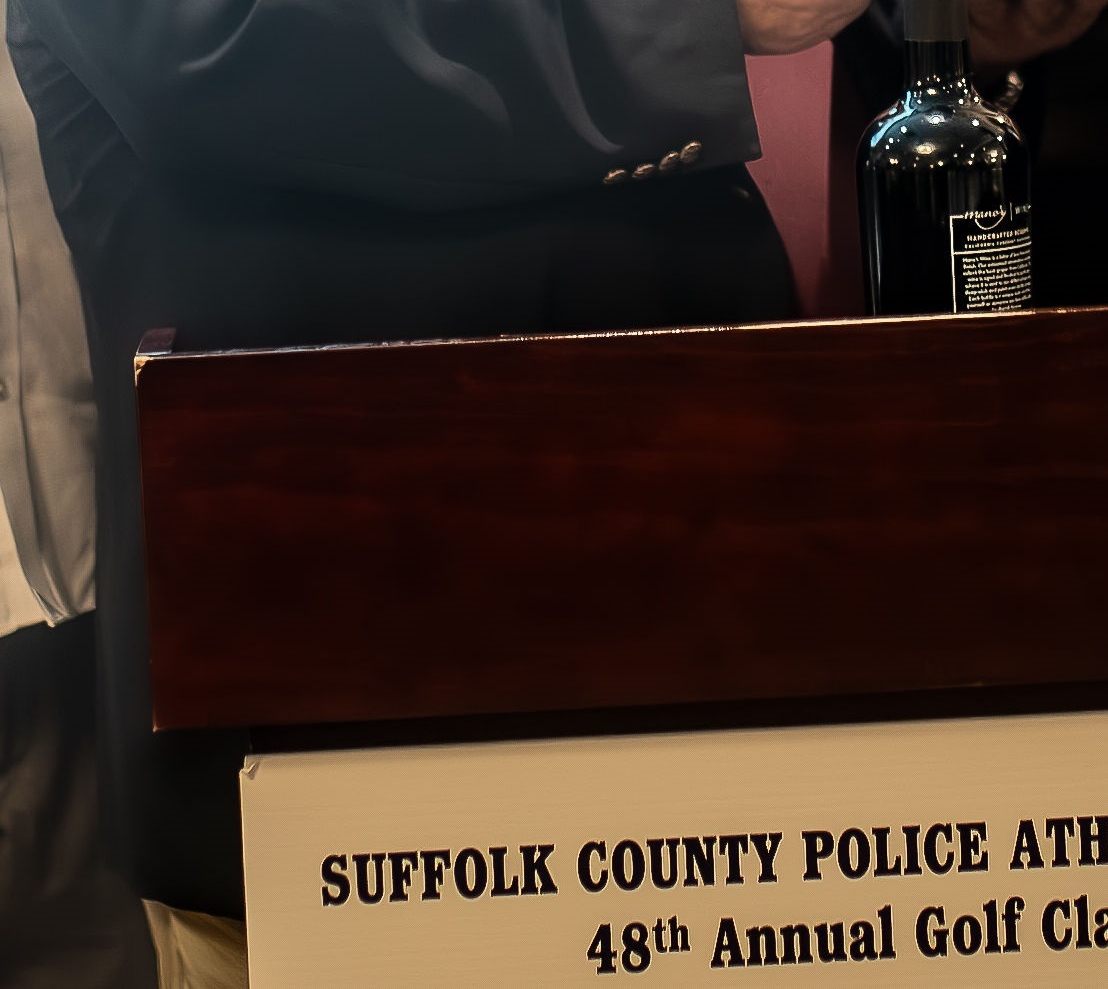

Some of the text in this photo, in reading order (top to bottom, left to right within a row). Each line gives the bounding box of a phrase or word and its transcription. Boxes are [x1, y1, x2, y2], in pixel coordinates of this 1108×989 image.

[322, 844, 558, 906] SUFFOLK
[578, 832, 782, 892] COUNTY
[802, 822, 988, 881] POLICE
[587, 916, 690, 974] 48th
[711, 905, 896, 968] Annual
[916, 897, 1024, 957] Golf
